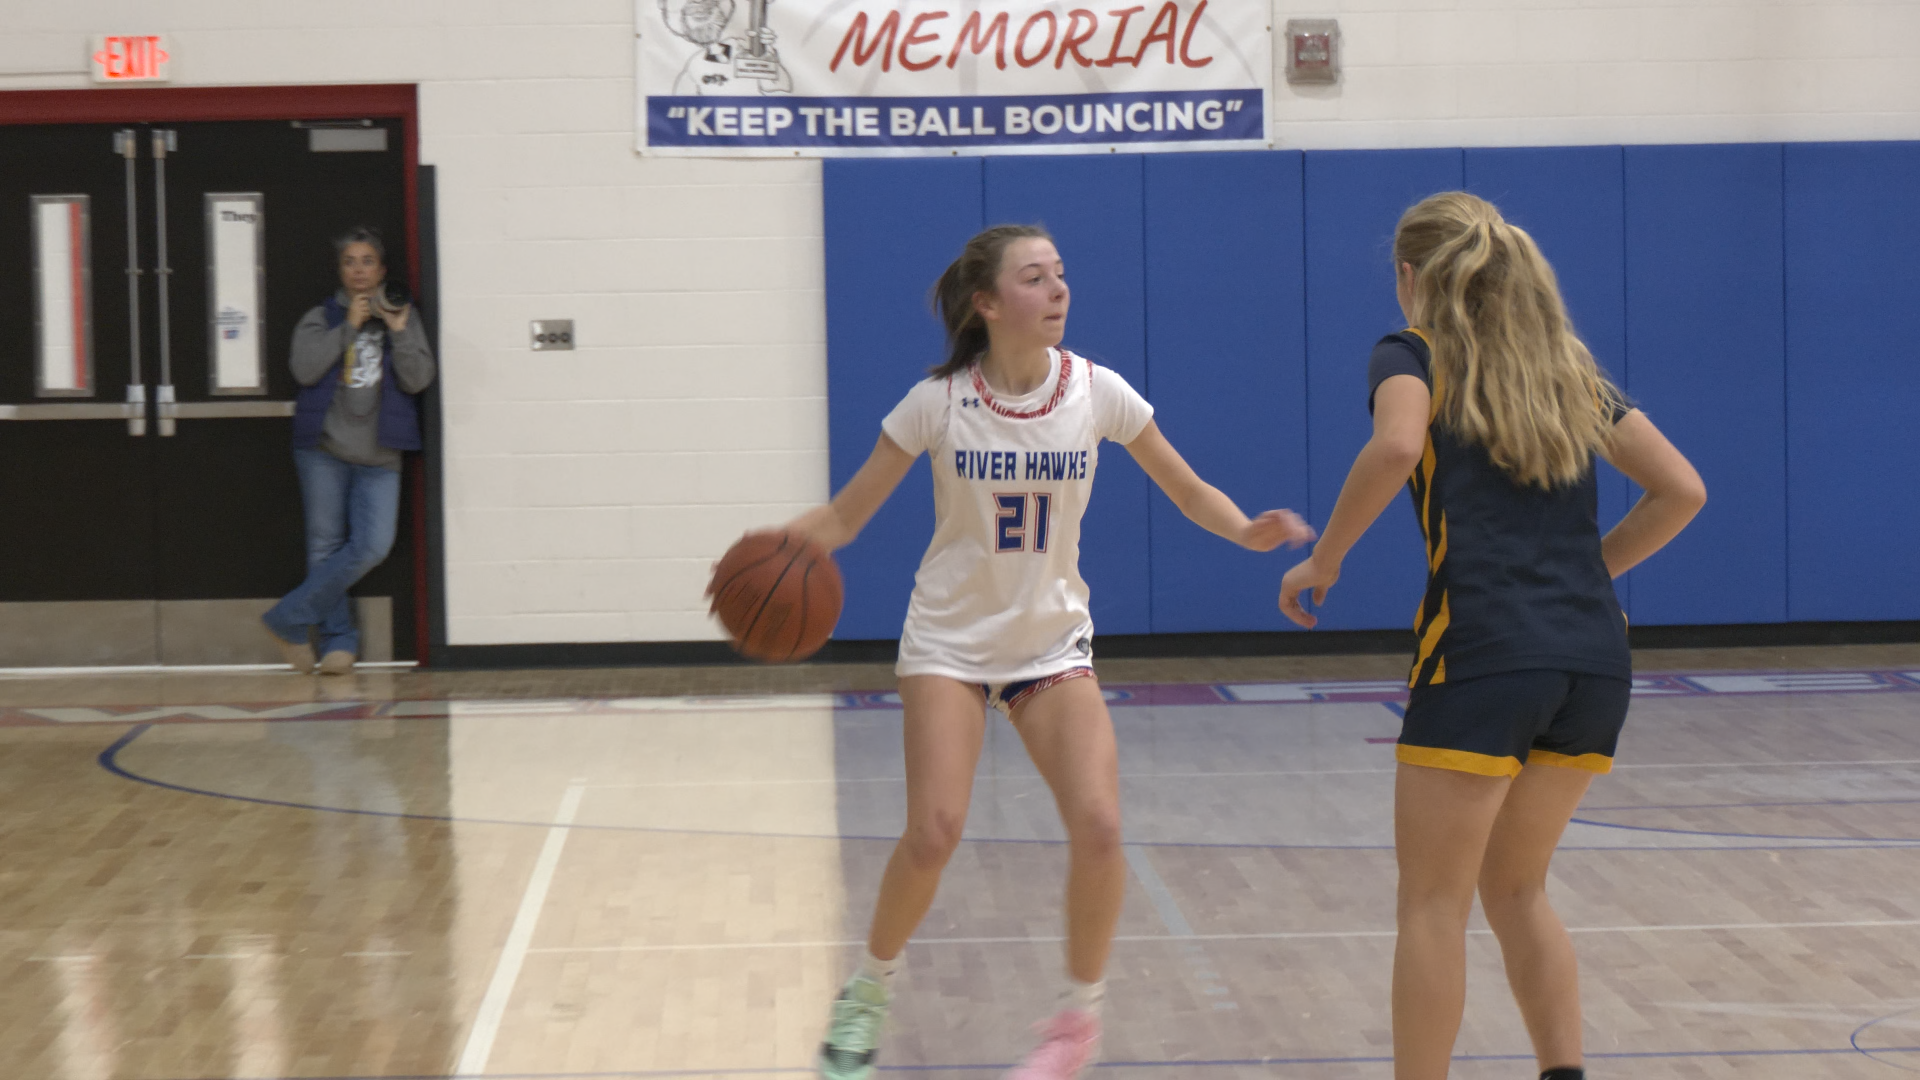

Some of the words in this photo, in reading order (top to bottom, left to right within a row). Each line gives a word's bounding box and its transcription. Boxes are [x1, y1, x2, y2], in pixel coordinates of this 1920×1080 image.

[103, 36, 161, 78] EXIT
[829, 1, 1213, 73] MEMORIAL
[799, 106, 881, 137] THE
[889, 106, 996, 137] BALL
[955, 450, 1017, 481] RIVER
[1024, 450, 1088, 481] HAWKS
[992, 492, 1052, 554] 21
